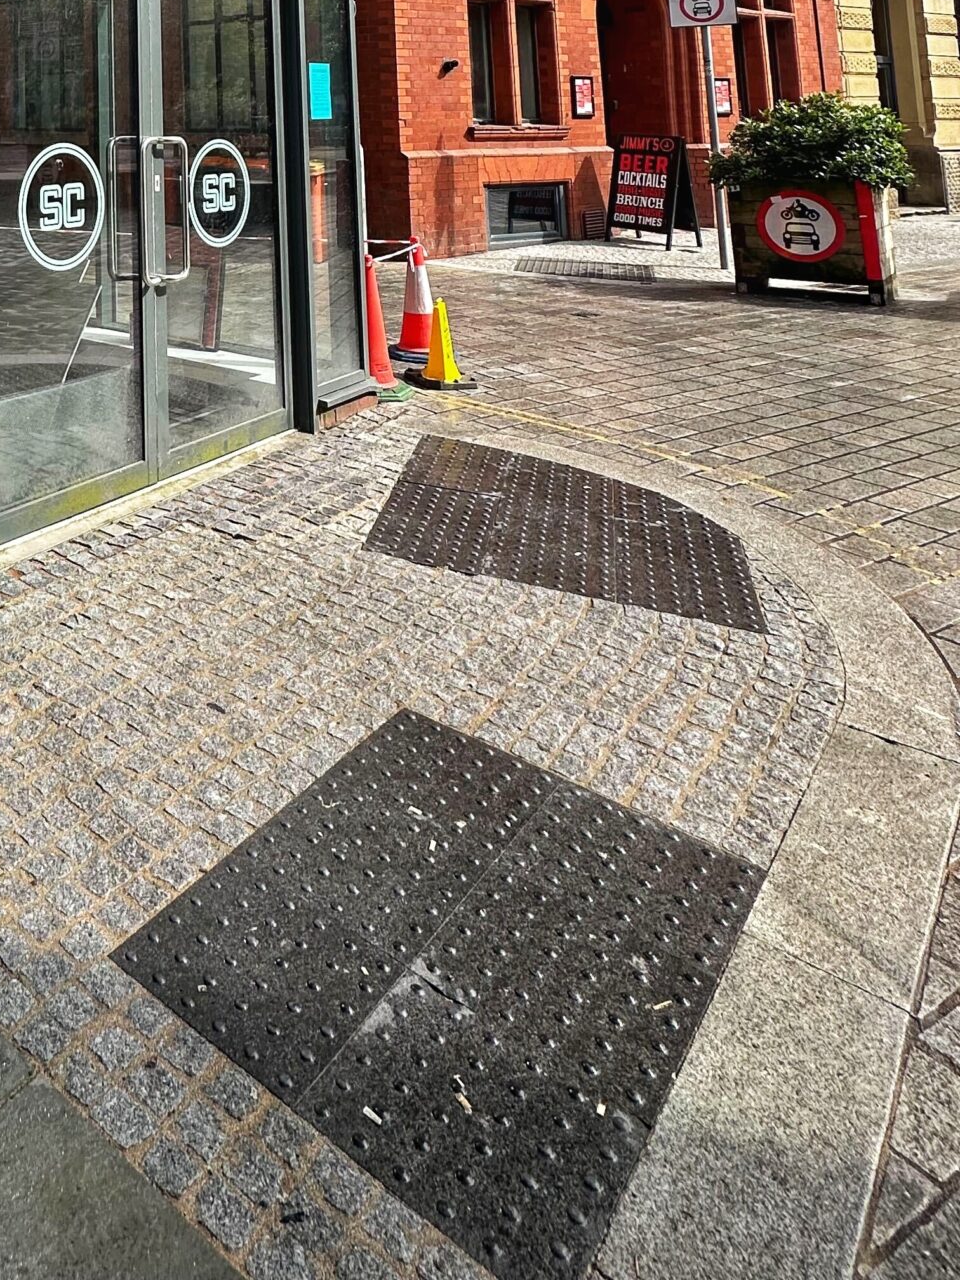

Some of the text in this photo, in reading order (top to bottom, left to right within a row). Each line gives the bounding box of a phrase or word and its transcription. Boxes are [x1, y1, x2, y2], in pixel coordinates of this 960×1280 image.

[620, 136, 660, 151] JIMMY'S
[620, 153, 669, 173] BEER
[617, 171, 667, 189] COCKTAILS
[202, 173, 236, 214] SC
[616, 193, 665, 209] BRUNCH
[39, 182, 85, 231] SC
[613, 213, 663, 227] GOOD TIMES
